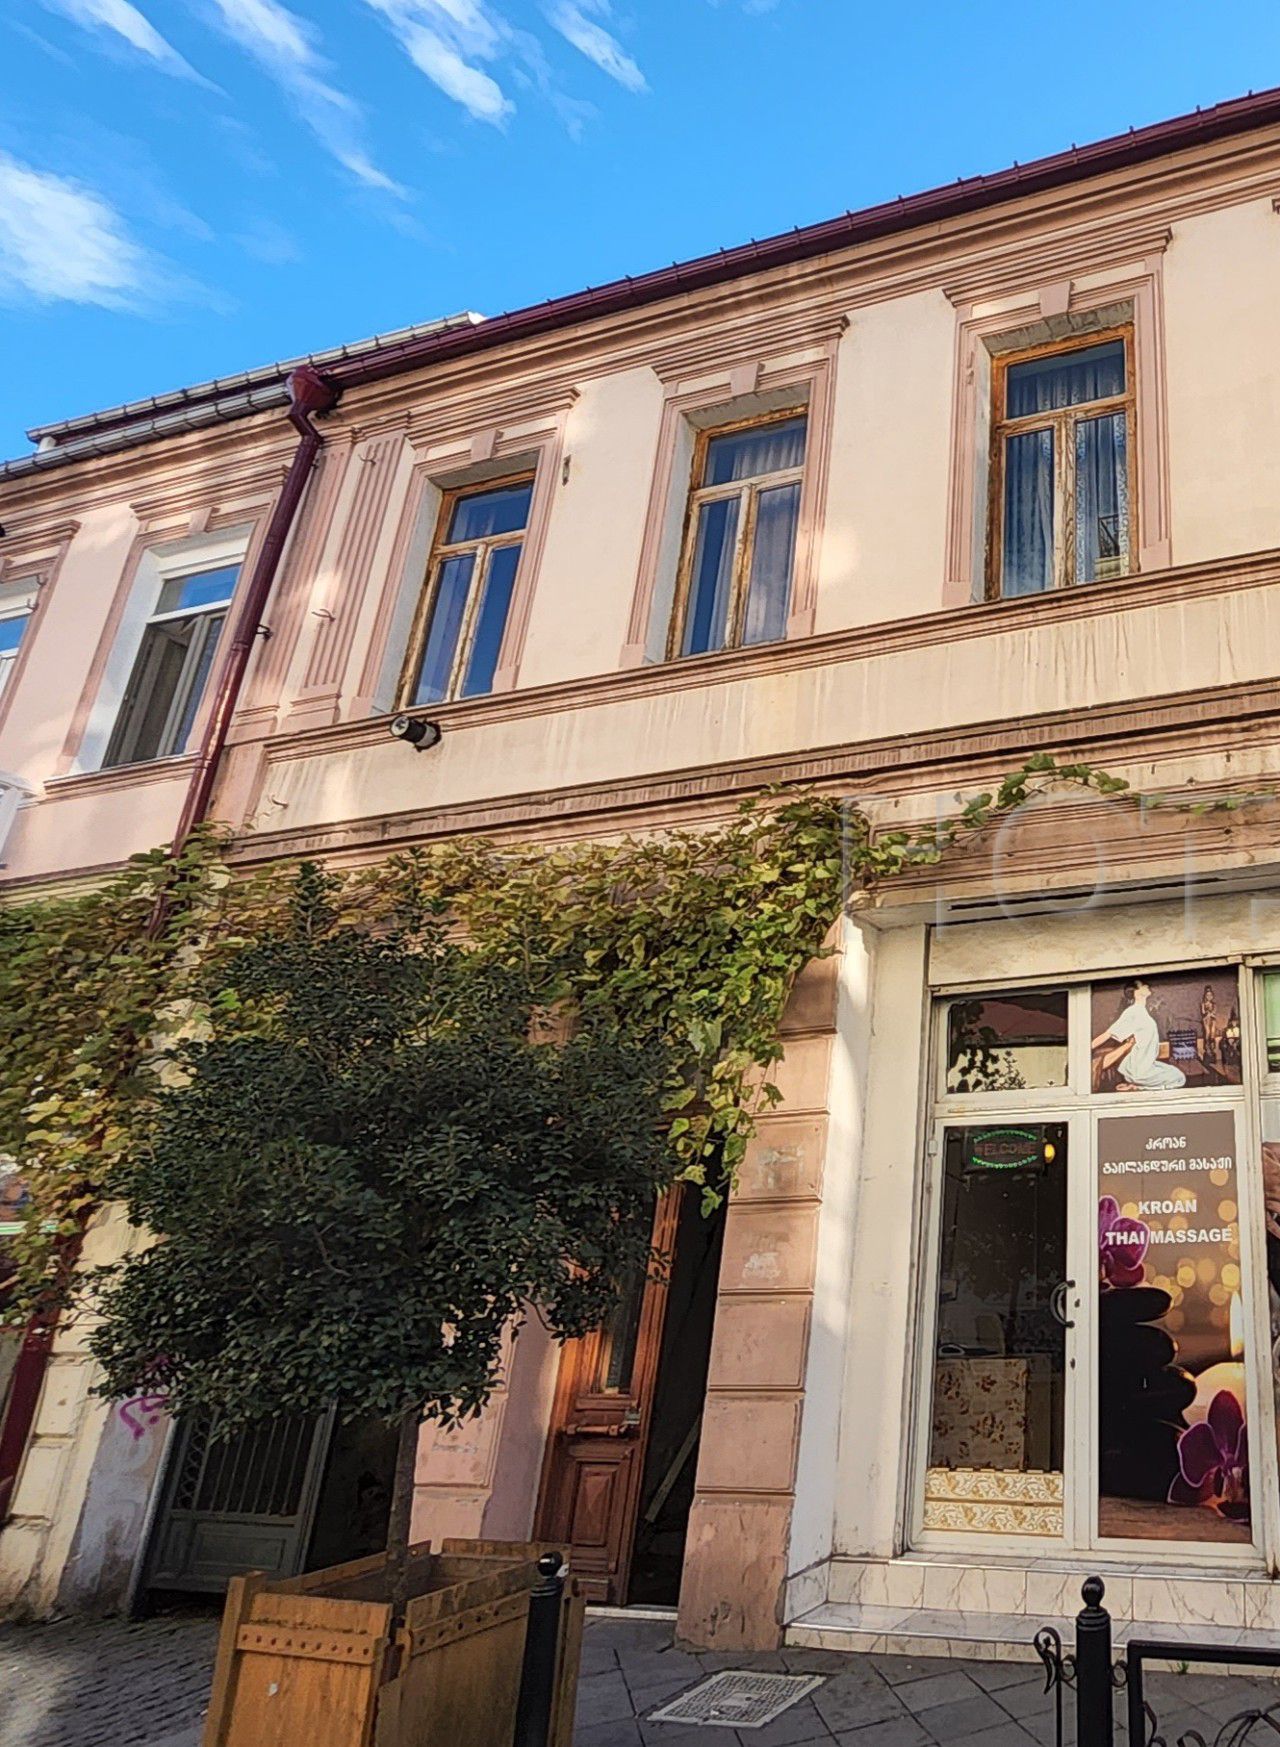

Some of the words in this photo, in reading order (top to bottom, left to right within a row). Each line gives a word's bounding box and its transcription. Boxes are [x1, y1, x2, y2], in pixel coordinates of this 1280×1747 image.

[1139, 1200, 1197, 1215] KROAN
[1105, 1232, 1145, 1246] THAI
[1150, 1228, 1233, 1244] MASSAGE
